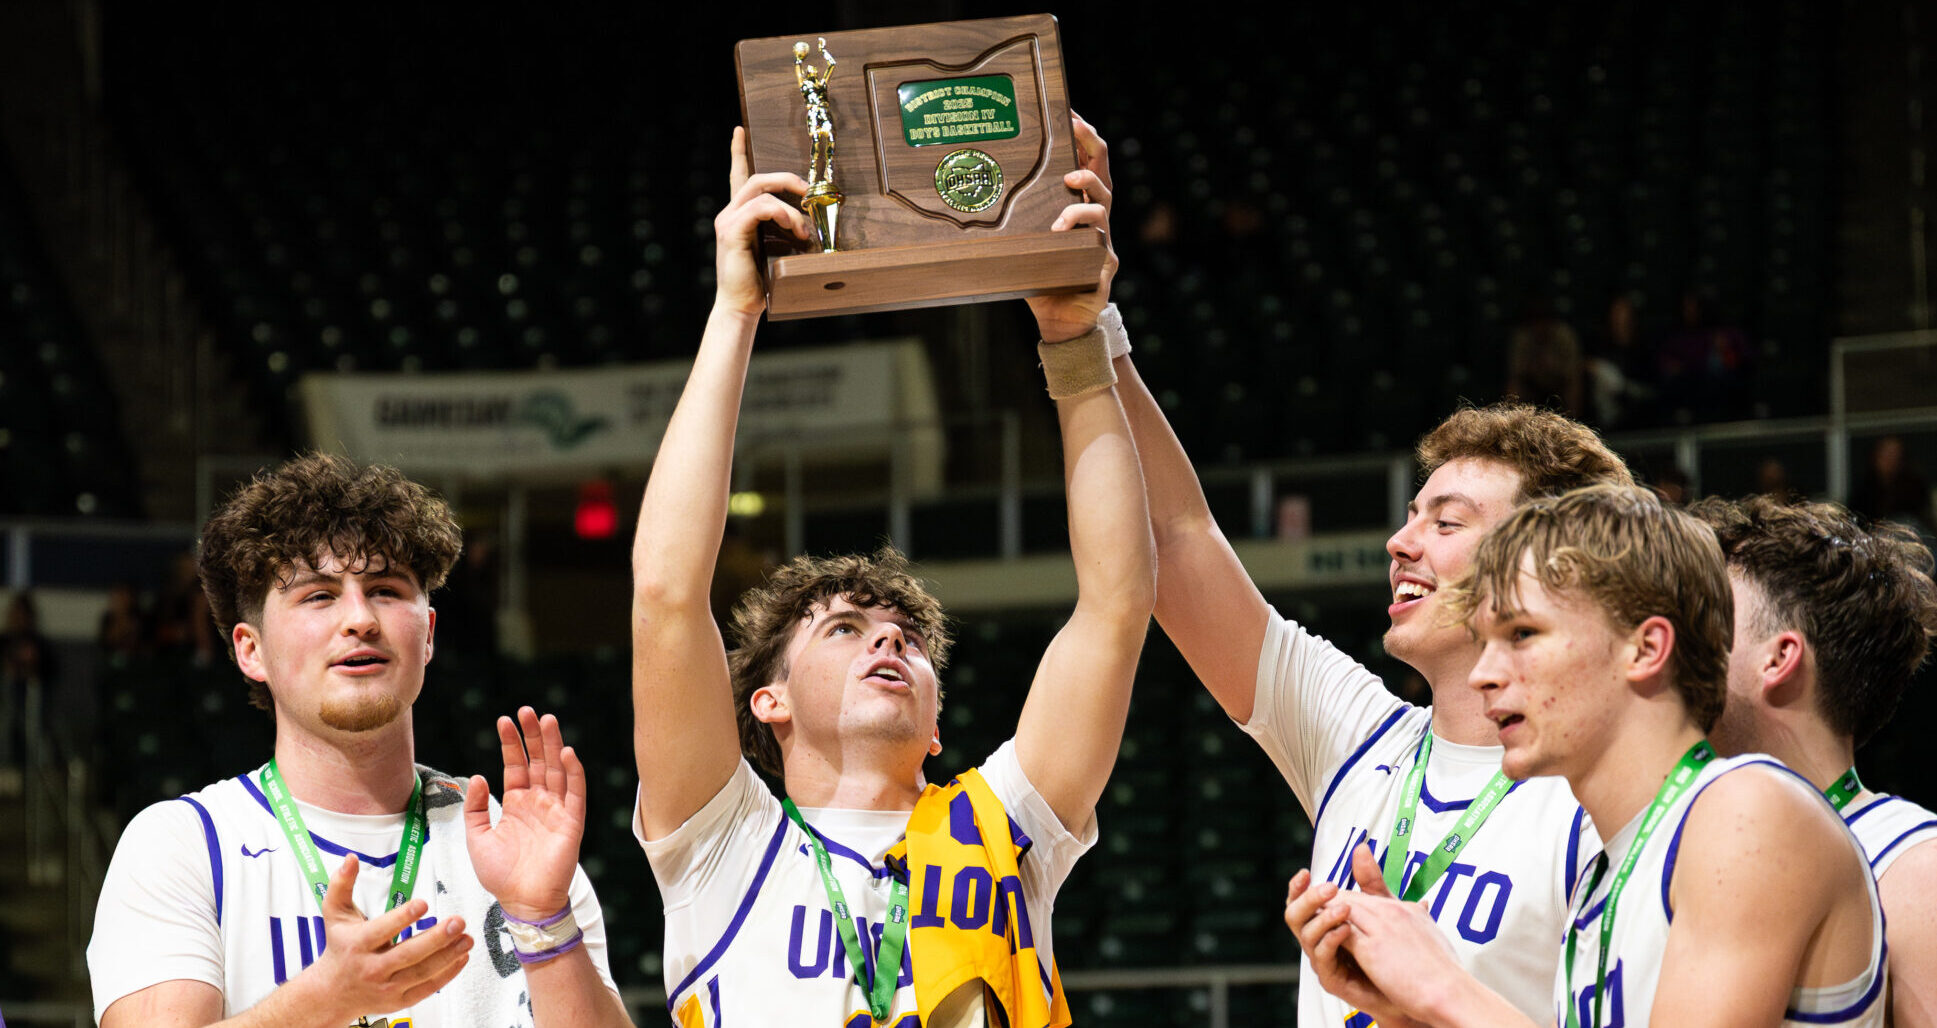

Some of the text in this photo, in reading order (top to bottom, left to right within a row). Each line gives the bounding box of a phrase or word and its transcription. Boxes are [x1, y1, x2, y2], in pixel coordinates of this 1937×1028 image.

[904, 86, 1012, 113] DISTRICT CHAMPION
[923, 108, 996, 125] DIVISION IV
[909, 121, 1015, 140] BOYS BASKETBALL
[409, 817, 421, 843] ATHLETIC
[400, 844, 417, 884] ASSOCIATION
